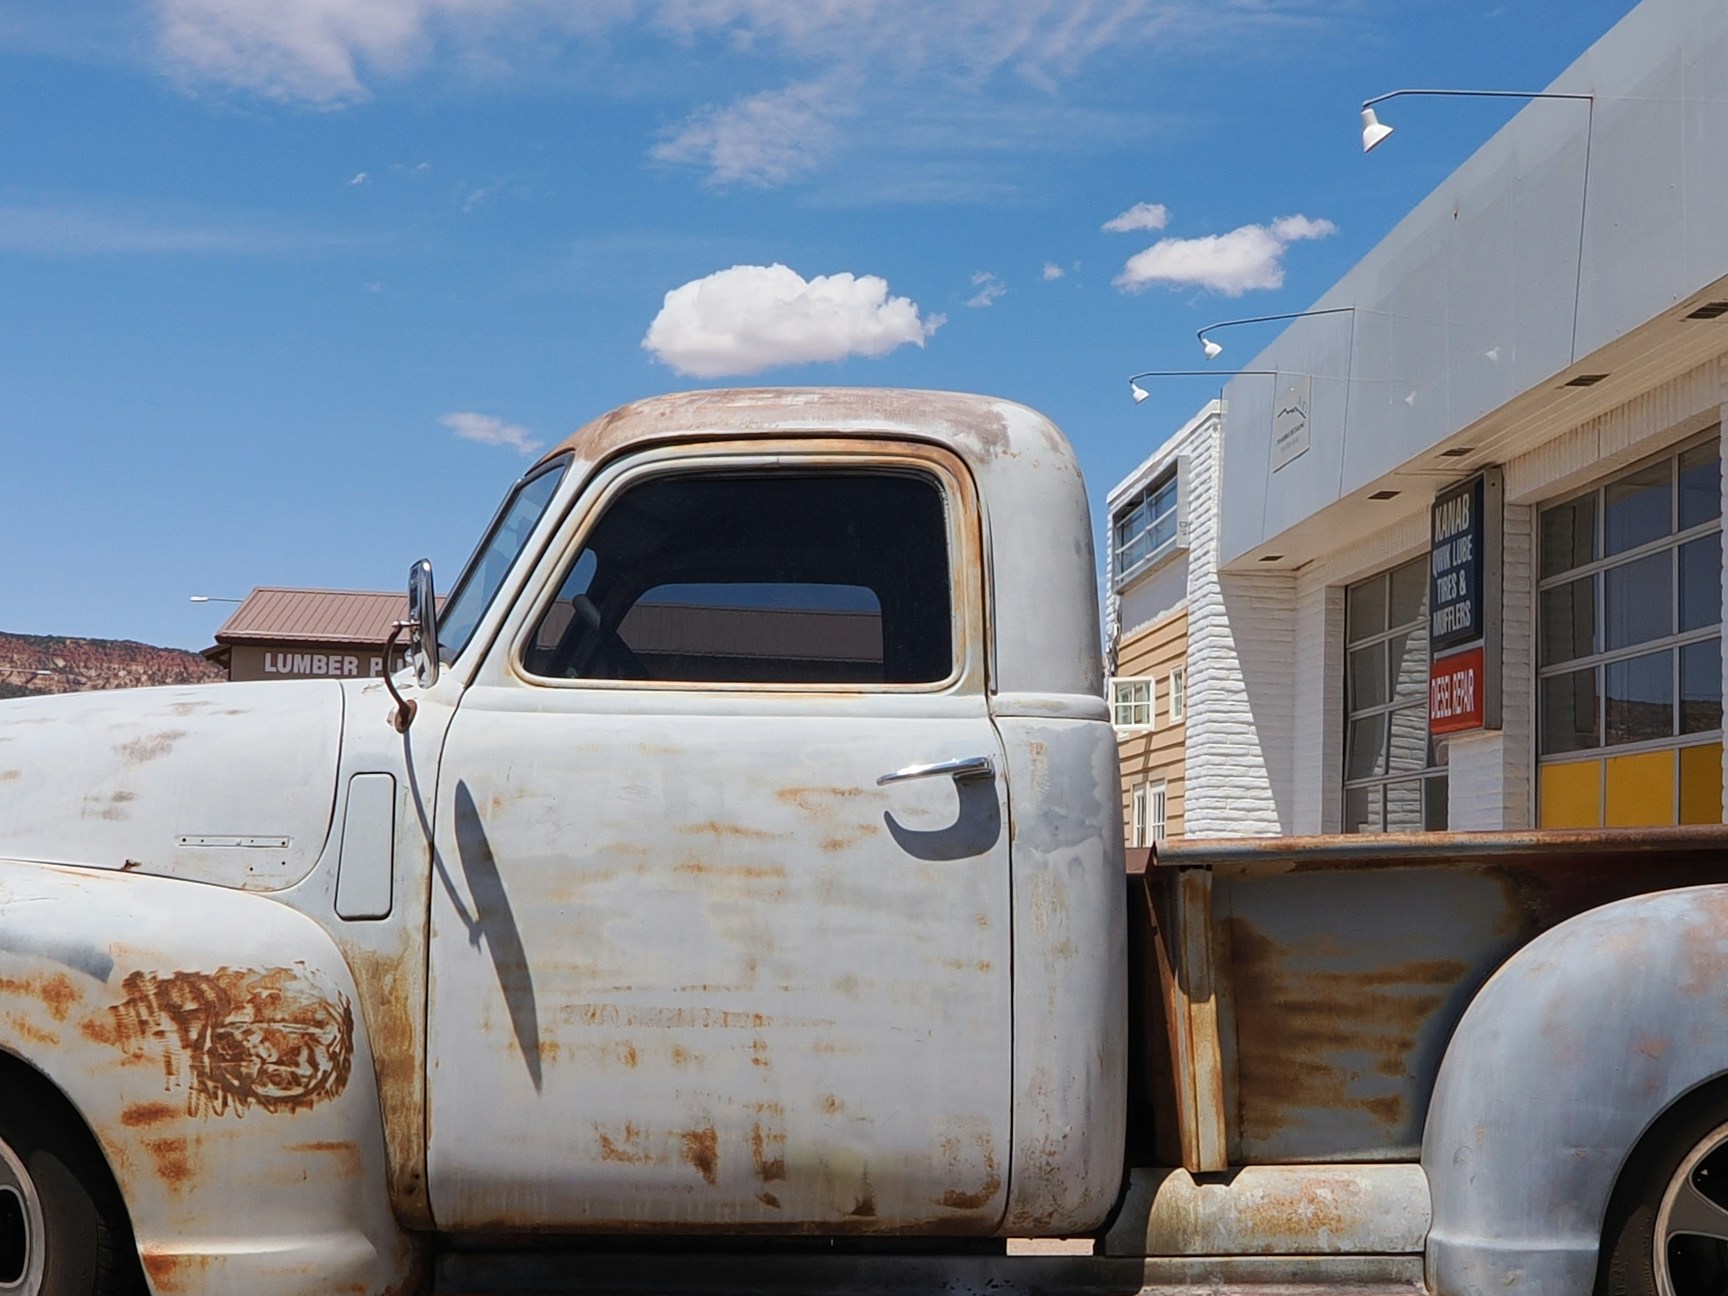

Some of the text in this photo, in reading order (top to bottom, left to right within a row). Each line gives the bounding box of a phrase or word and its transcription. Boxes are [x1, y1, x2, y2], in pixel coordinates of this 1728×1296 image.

[1435, 492, 1470, 543] KANAB
[1452, 534, 1473, 567] LUBE
[1437, 569, 1467, 604] TIRES &
[1433, 599, 1471, 637] MUFFLERS
[264, 652, 359, 676] LUMBER
[1431, 668, 1475, 720] DIESEL REPAIR
